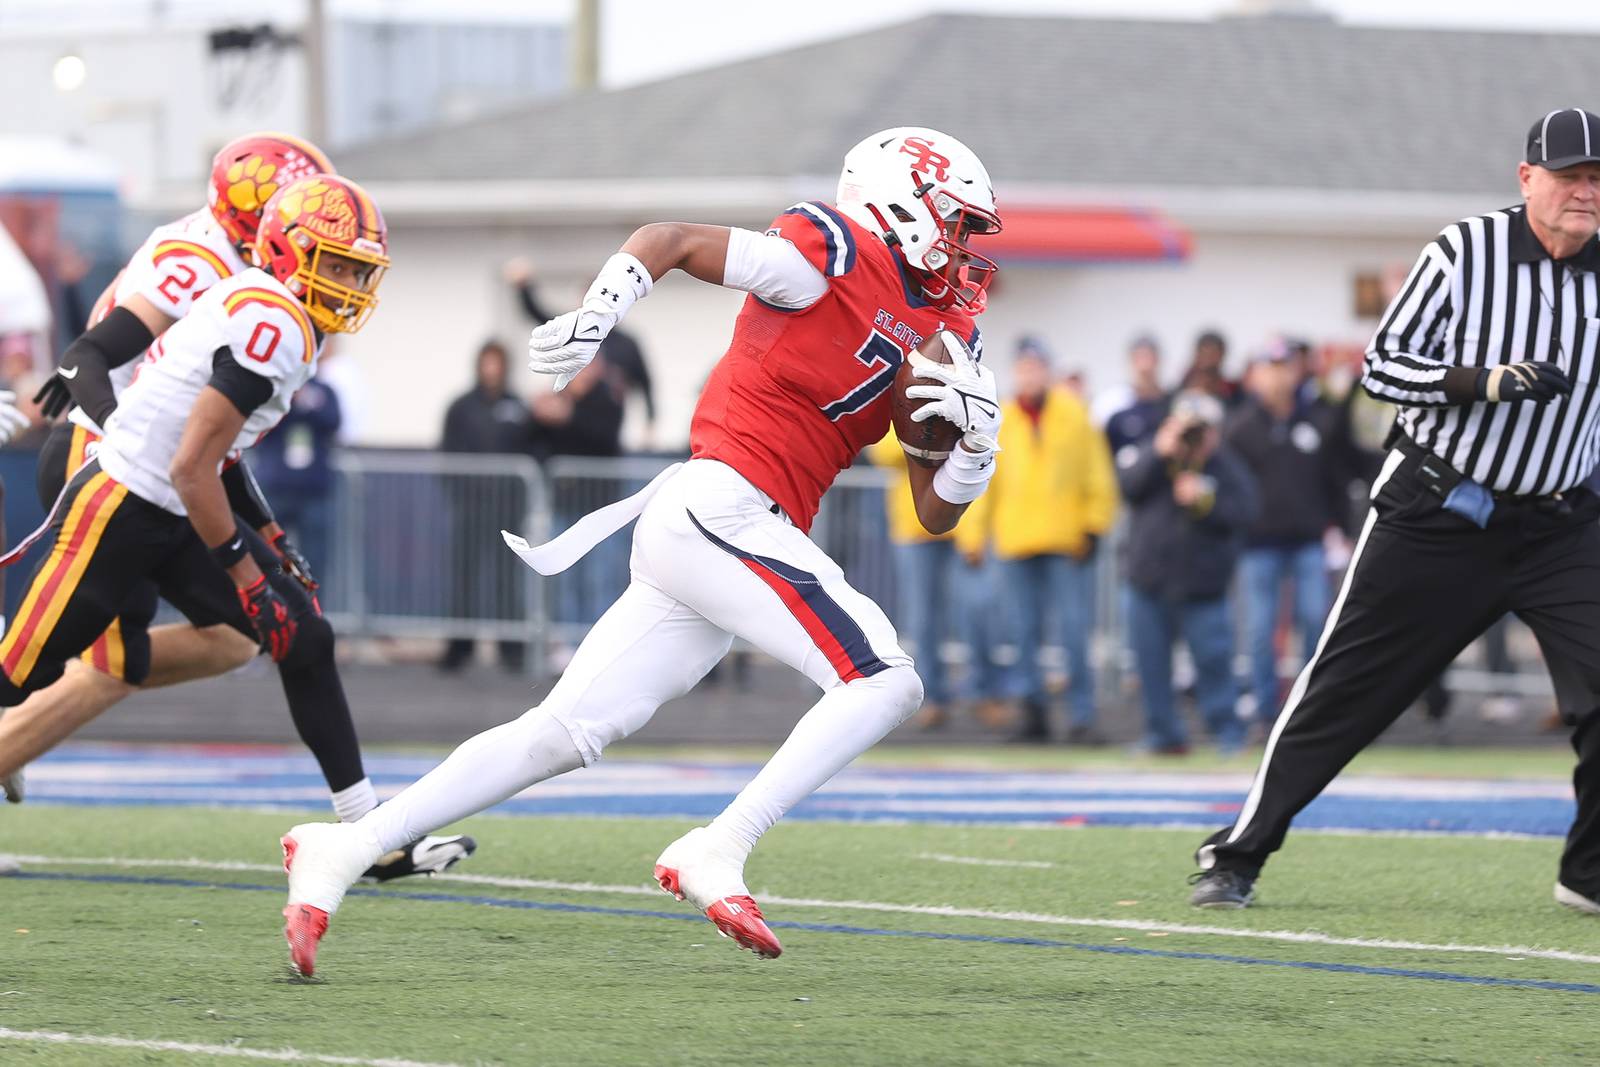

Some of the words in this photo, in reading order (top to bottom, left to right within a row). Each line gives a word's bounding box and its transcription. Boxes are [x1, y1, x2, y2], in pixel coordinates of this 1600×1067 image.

[899, 136, 951, 183] SR
[158, 264, 210, 304] 2
[245, 321, 282, 364] 0
[819, 328, 905, 423] 7
